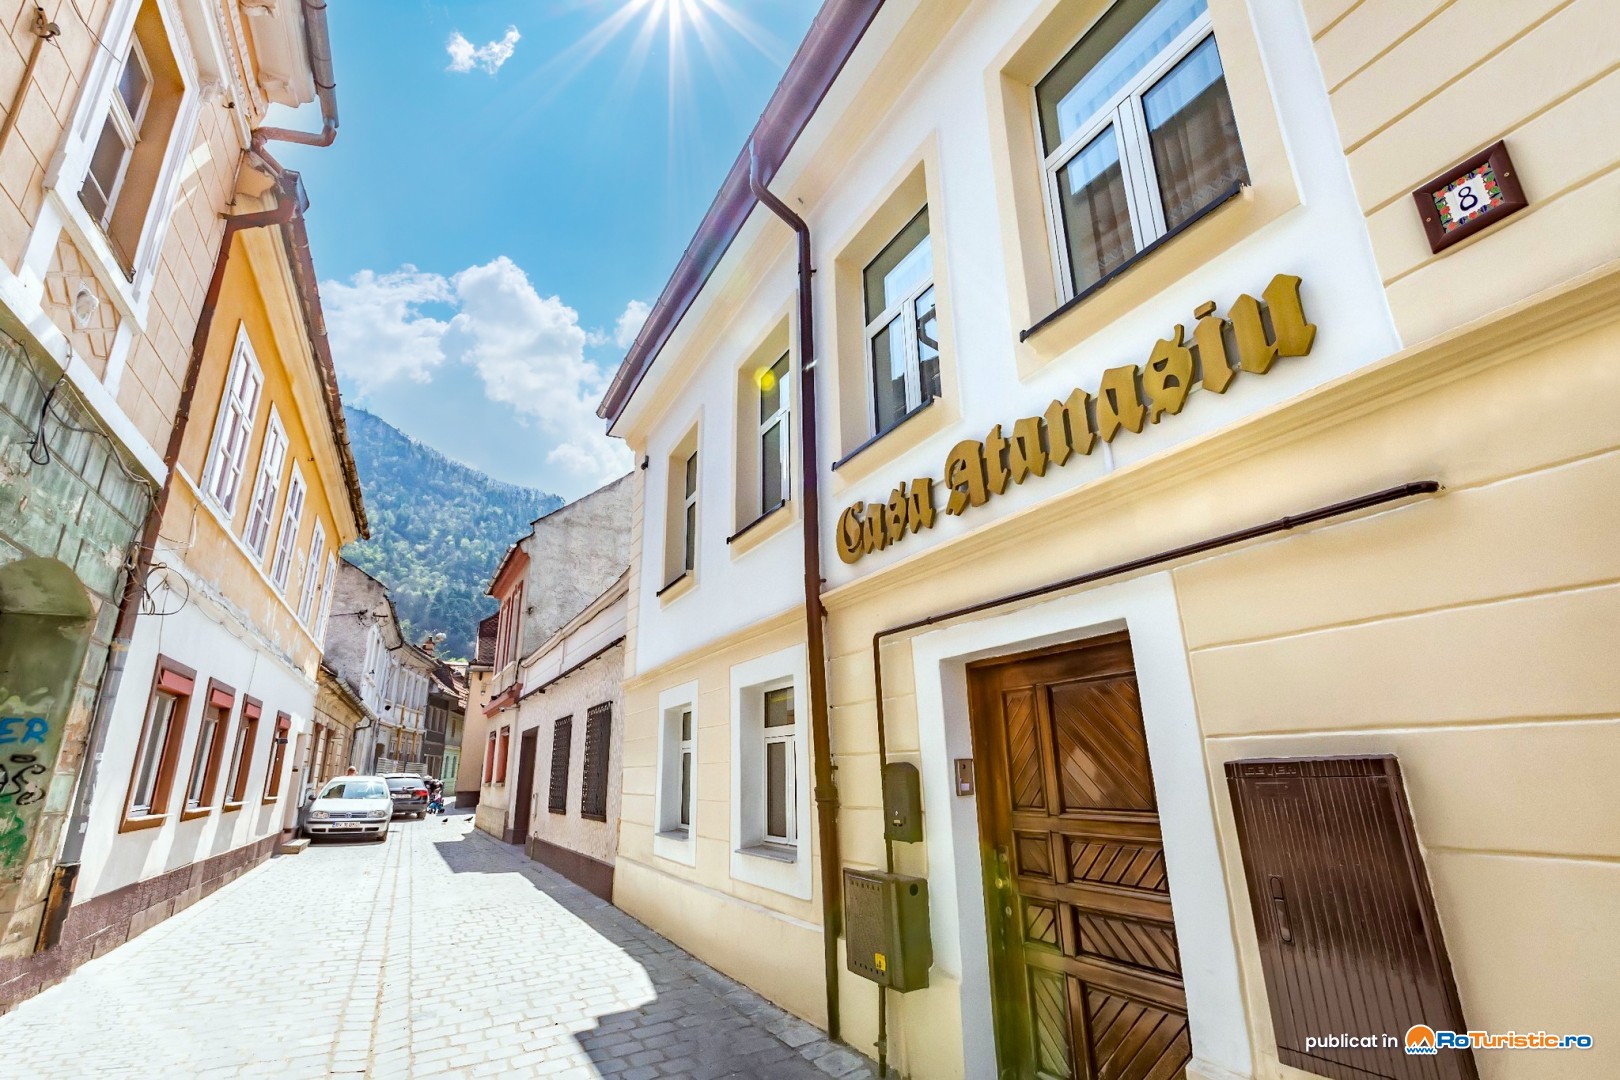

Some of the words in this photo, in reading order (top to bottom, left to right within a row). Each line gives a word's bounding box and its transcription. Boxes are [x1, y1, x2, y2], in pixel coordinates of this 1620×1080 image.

[1457, 186, 1479, 212] 8
[836, 478, 936, 565] Casa
[944, 273, 1318, 517] Atanasiu
